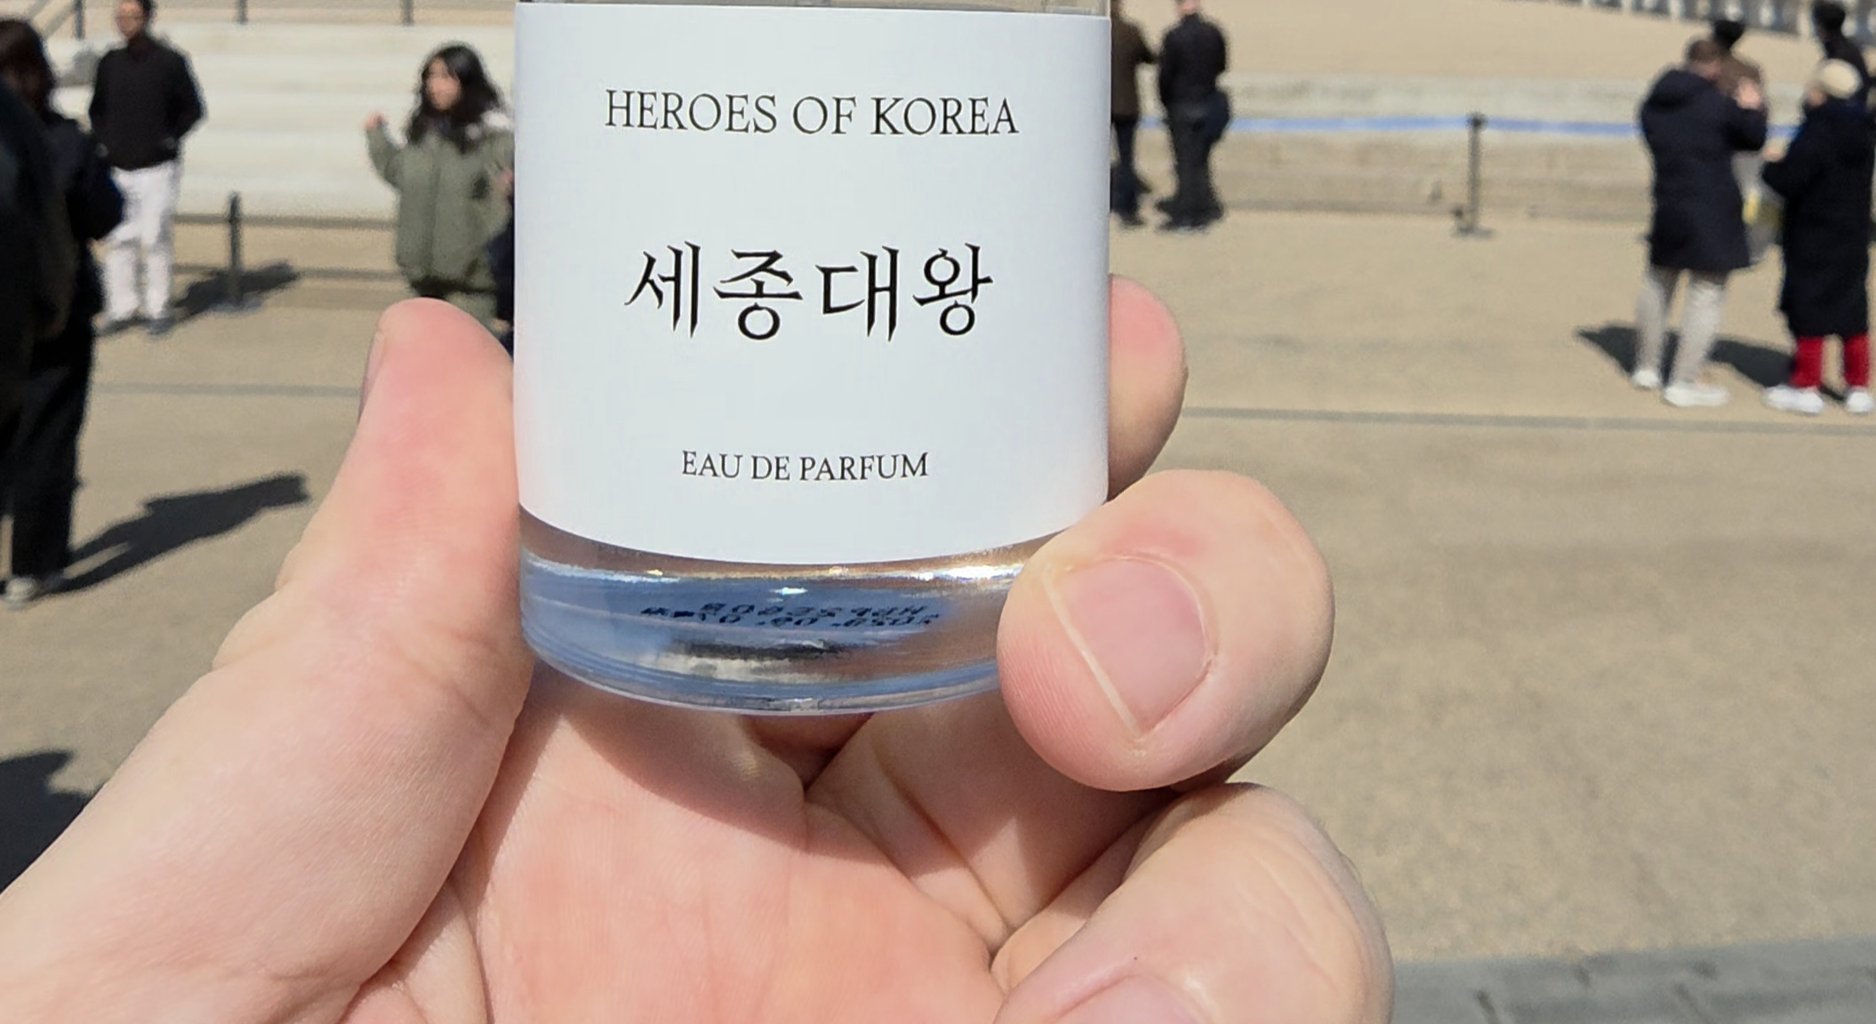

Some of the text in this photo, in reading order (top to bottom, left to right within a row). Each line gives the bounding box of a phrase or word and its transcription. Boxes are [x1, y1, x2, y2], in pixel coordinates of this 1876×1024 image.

[605, 89, 1019, 136] HEROES OF KOREA
[624, 240, 994, 342] 세종대왕
[682, 450, 928, 481] EAU DE PARFUM
